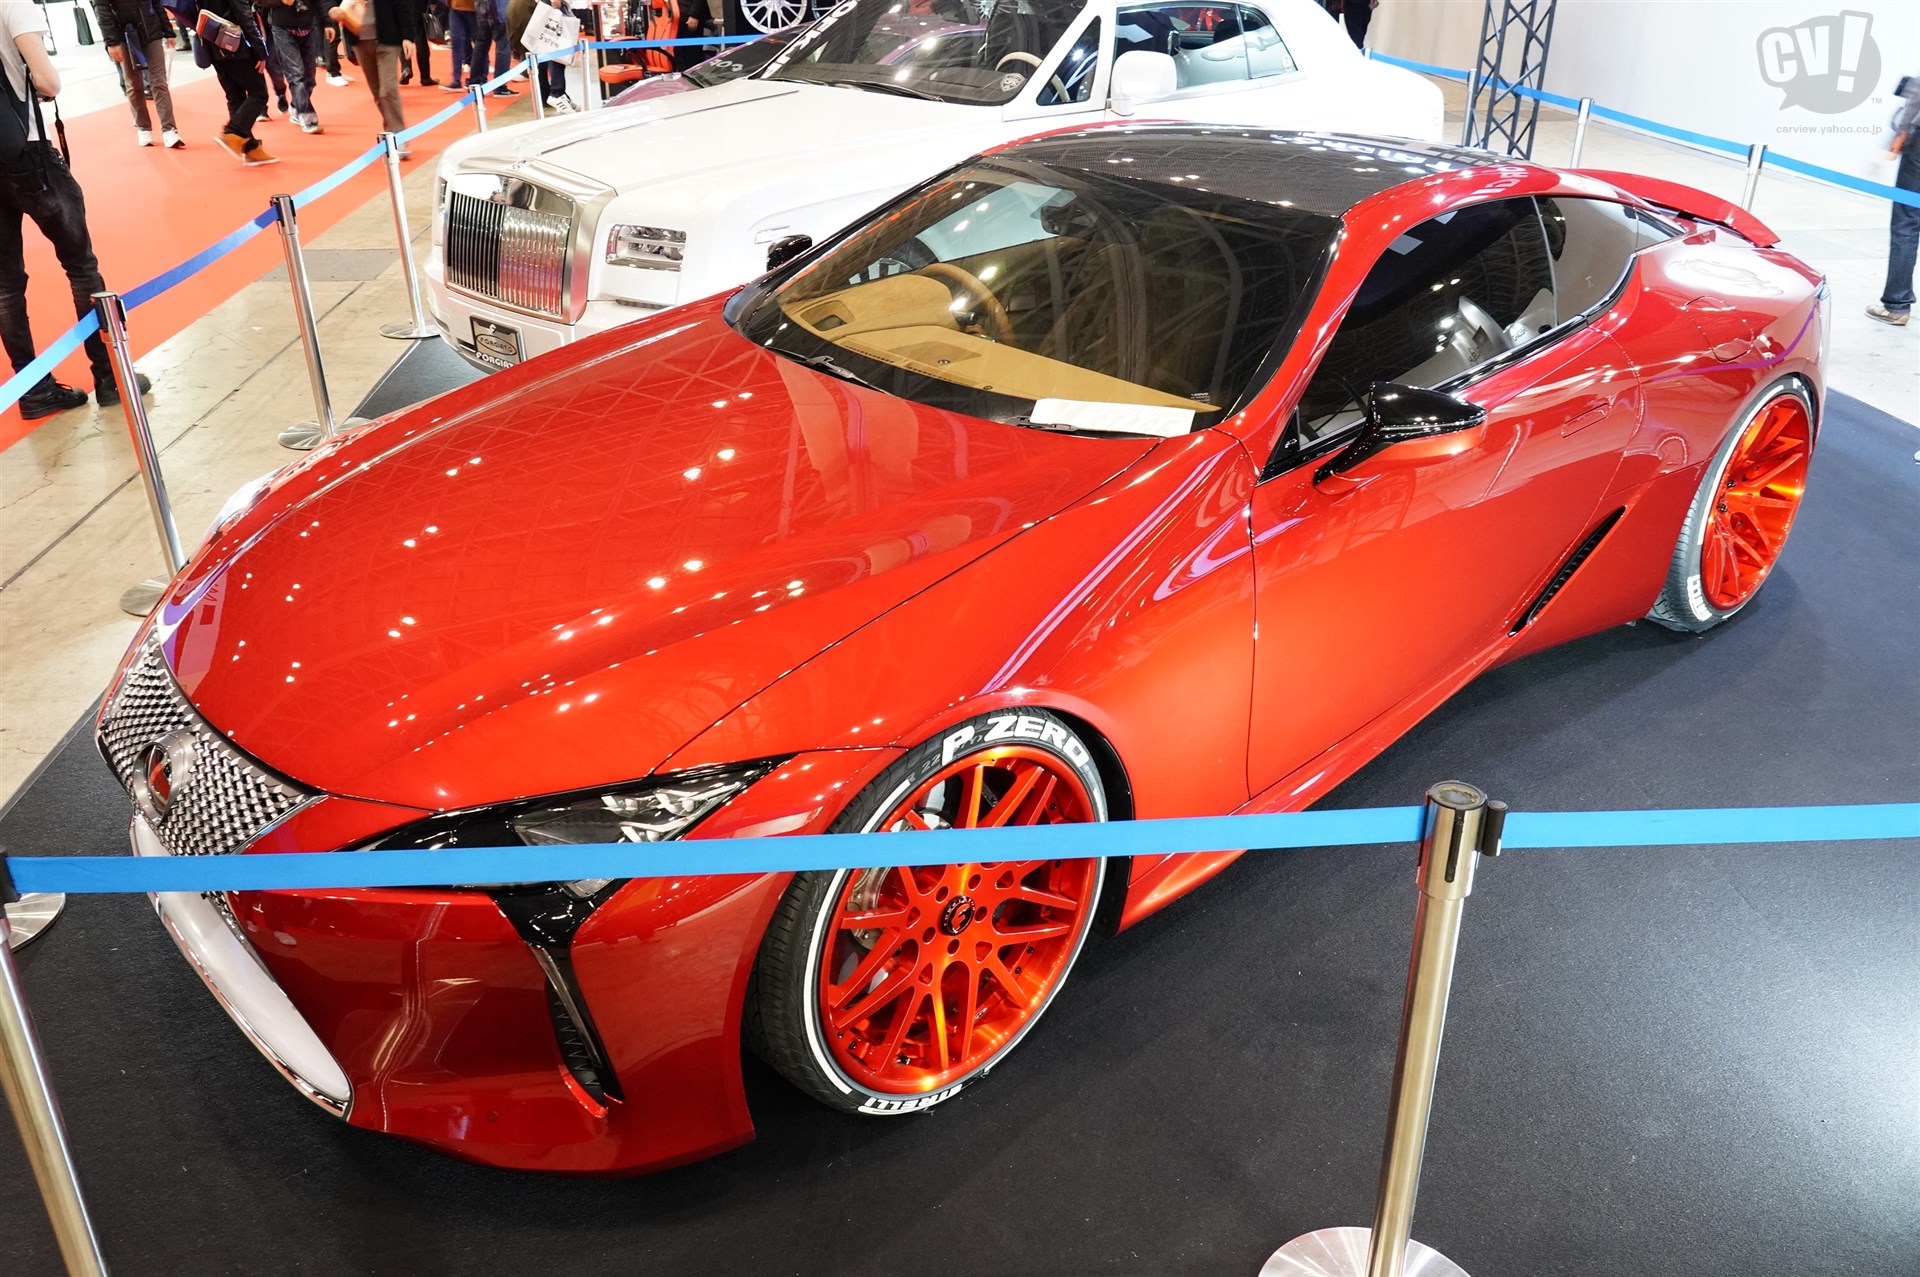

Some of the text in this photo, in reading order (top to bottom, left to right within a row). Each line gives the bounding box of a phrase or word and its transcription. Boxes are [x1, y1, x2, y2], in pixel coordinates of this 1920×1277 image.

[480, 337, 513, 353] FORGIATO
[476, 351, 514, 369] FORGIAT
[942, 715, 1090, 769] P ZERO
